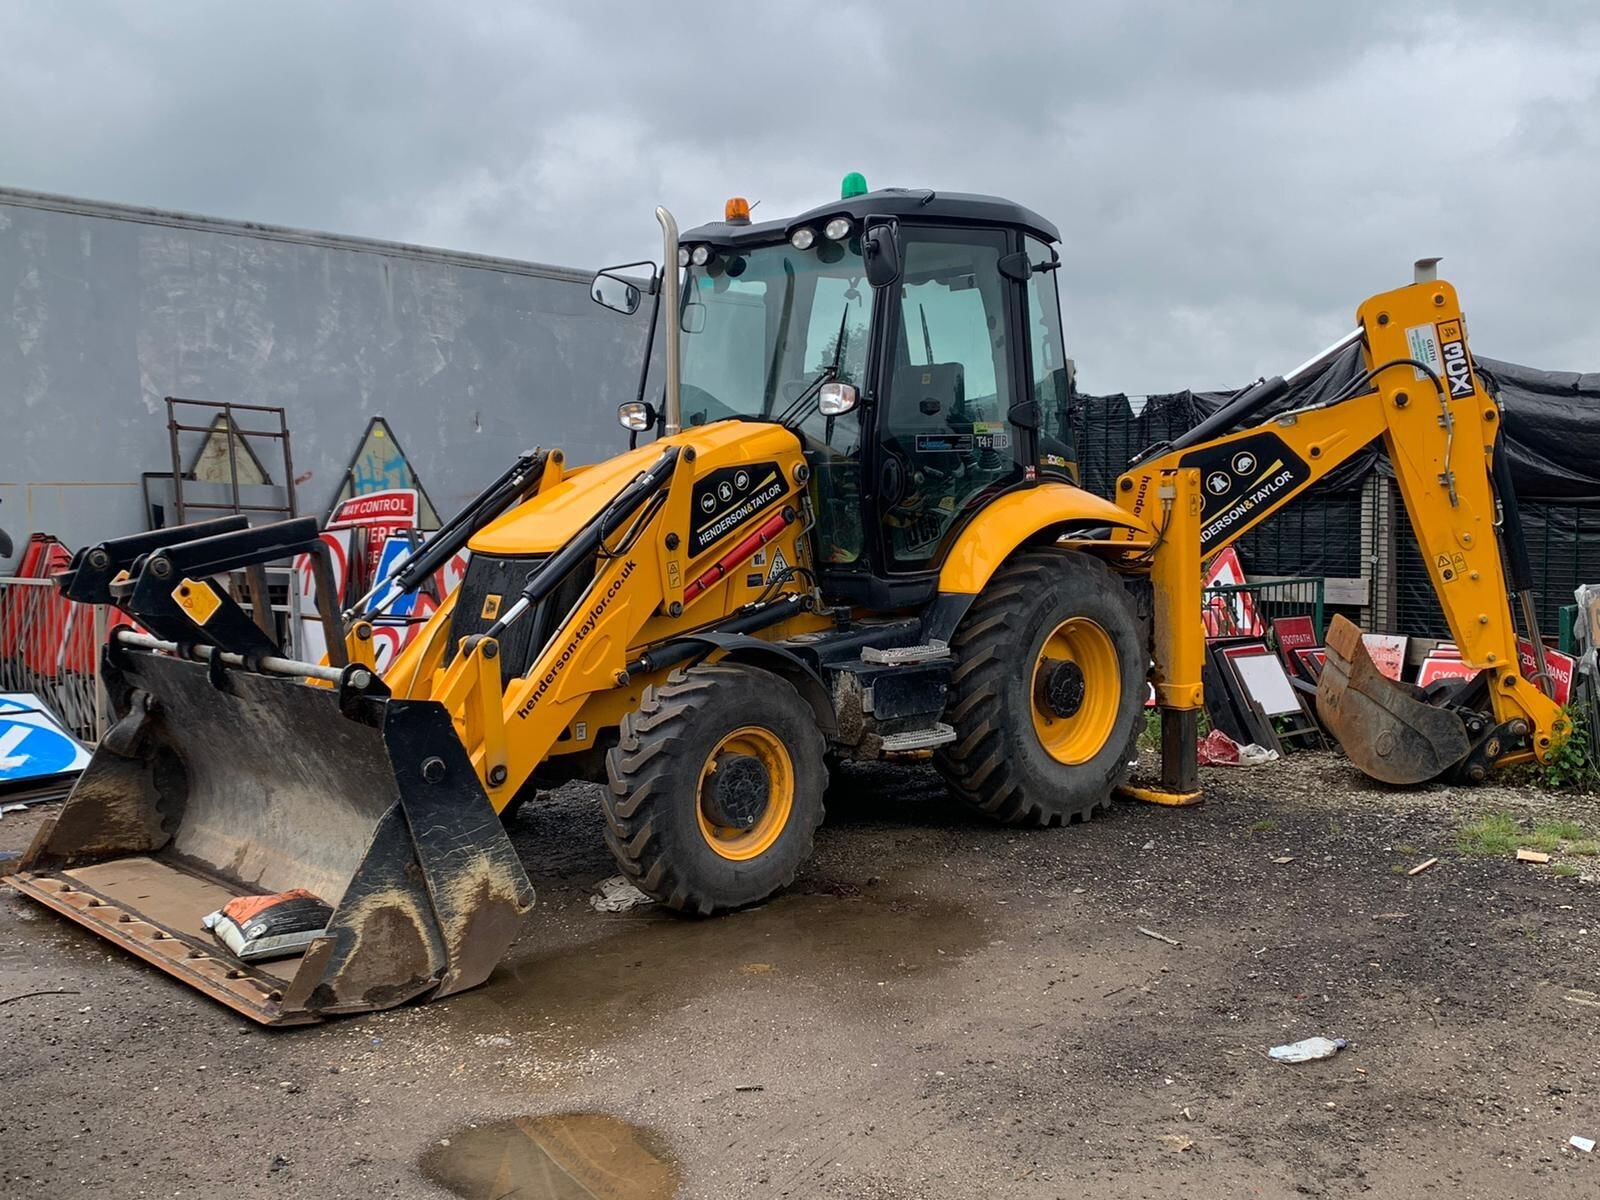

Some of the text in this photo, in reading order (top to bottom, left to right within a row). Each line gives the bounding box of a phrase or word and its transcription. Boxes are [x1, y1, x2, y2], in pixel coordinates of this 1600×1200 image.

[1426, 338, 1437, 362] GEITH
[1443, 341, 1473, 394] 3CX
[360, 498, 408, 513] CONTROL
[698, 483, 782, 546] HENDERSON&TAYLOR
[1199, 470, 1294, 544] NDERSON&TAYLOR
[516, 558, 637, 720] henderson-taylor.co.uk
[1280, 633, 1313, 645] FOOTPATH
